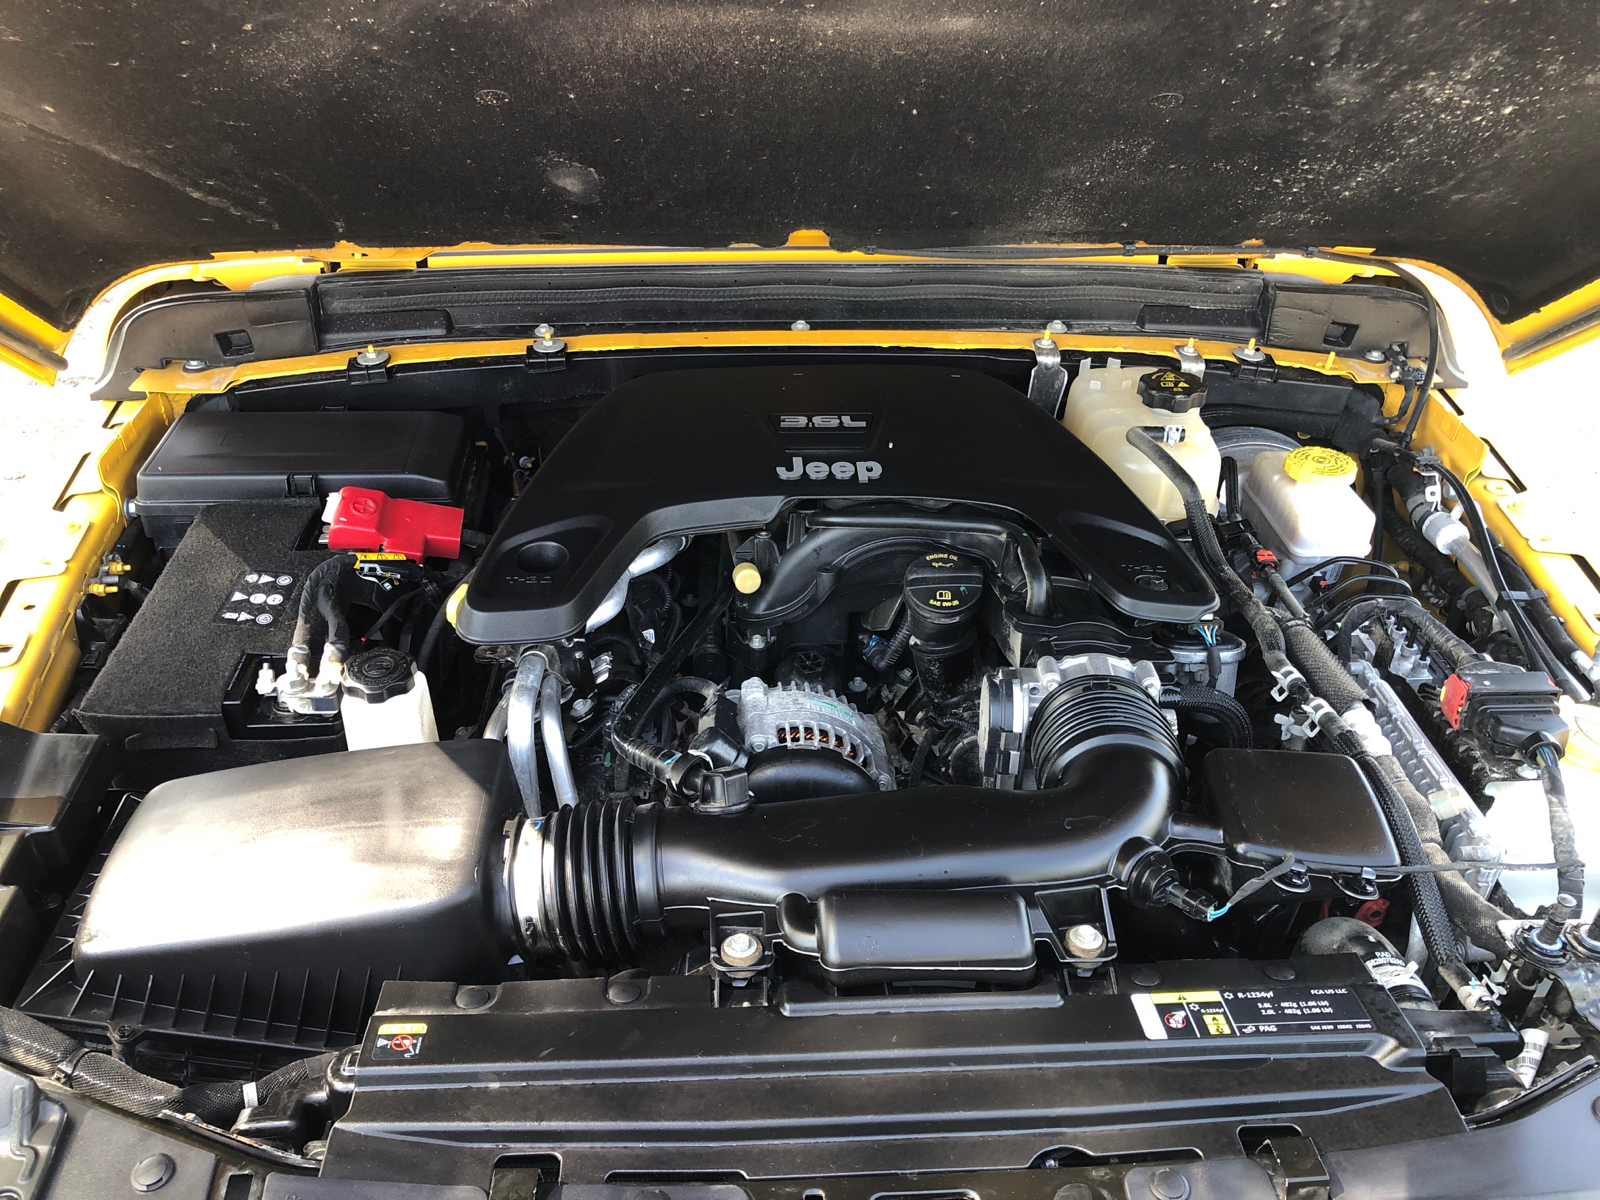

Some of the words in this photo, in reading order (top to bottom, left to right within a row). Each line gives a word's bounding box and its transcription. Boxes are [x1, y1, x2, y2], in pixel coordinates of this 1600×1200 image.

[780, 415, 867, 428] 3.6L
[776, 457, 882, 483] Jeep
[1237, 991, 1274, 999] R-1234yf
